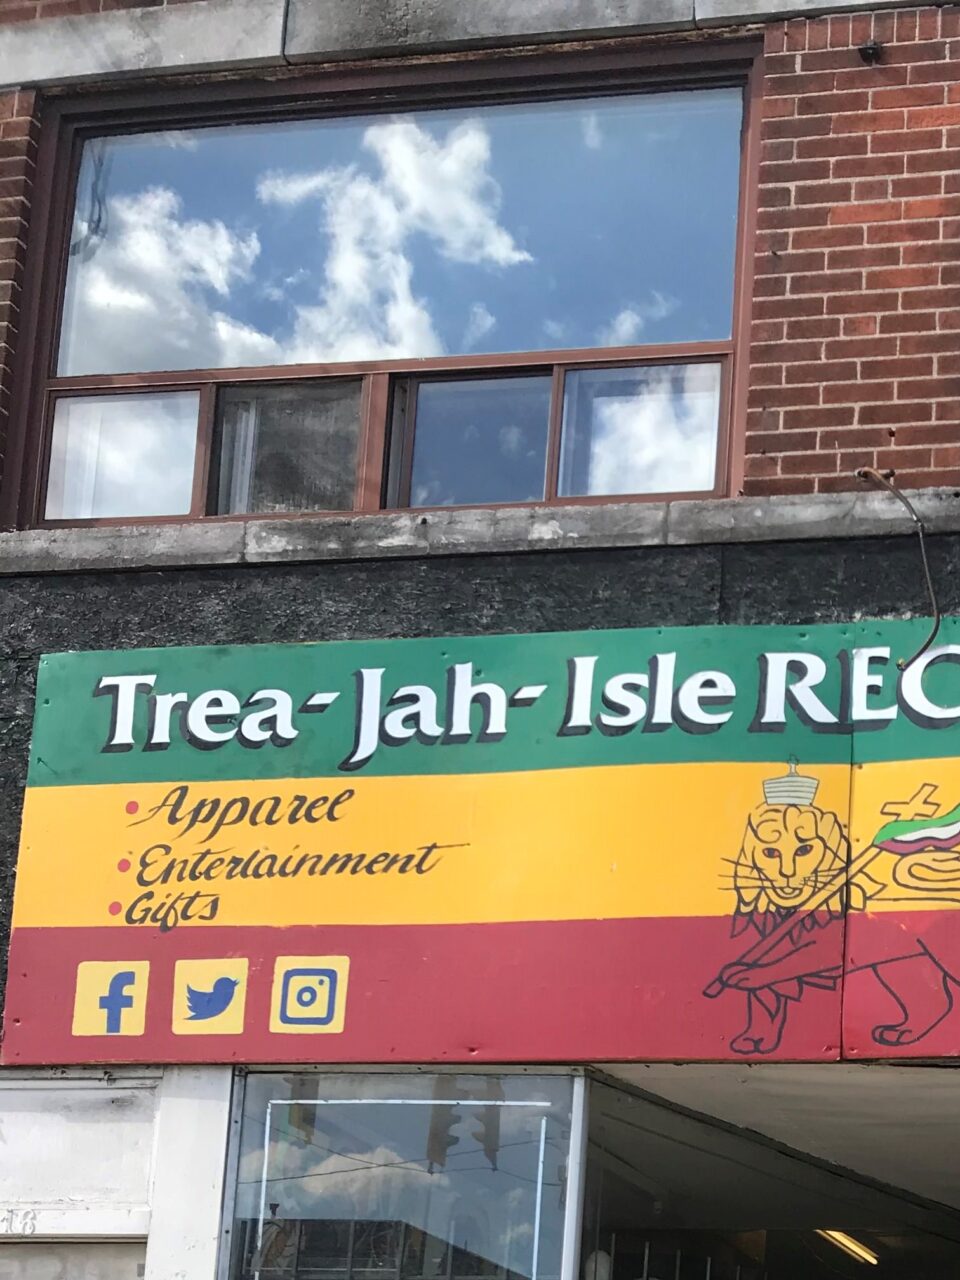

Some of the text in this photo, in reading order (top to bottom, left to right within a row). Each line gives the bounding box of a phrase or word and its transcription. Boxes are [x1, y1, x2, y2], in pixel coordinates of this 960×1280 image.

[126, 785, 354, 844] Apparel
[135, 841, 472, 888] Entertainment
[124, 889, 220, 933] Gifts
